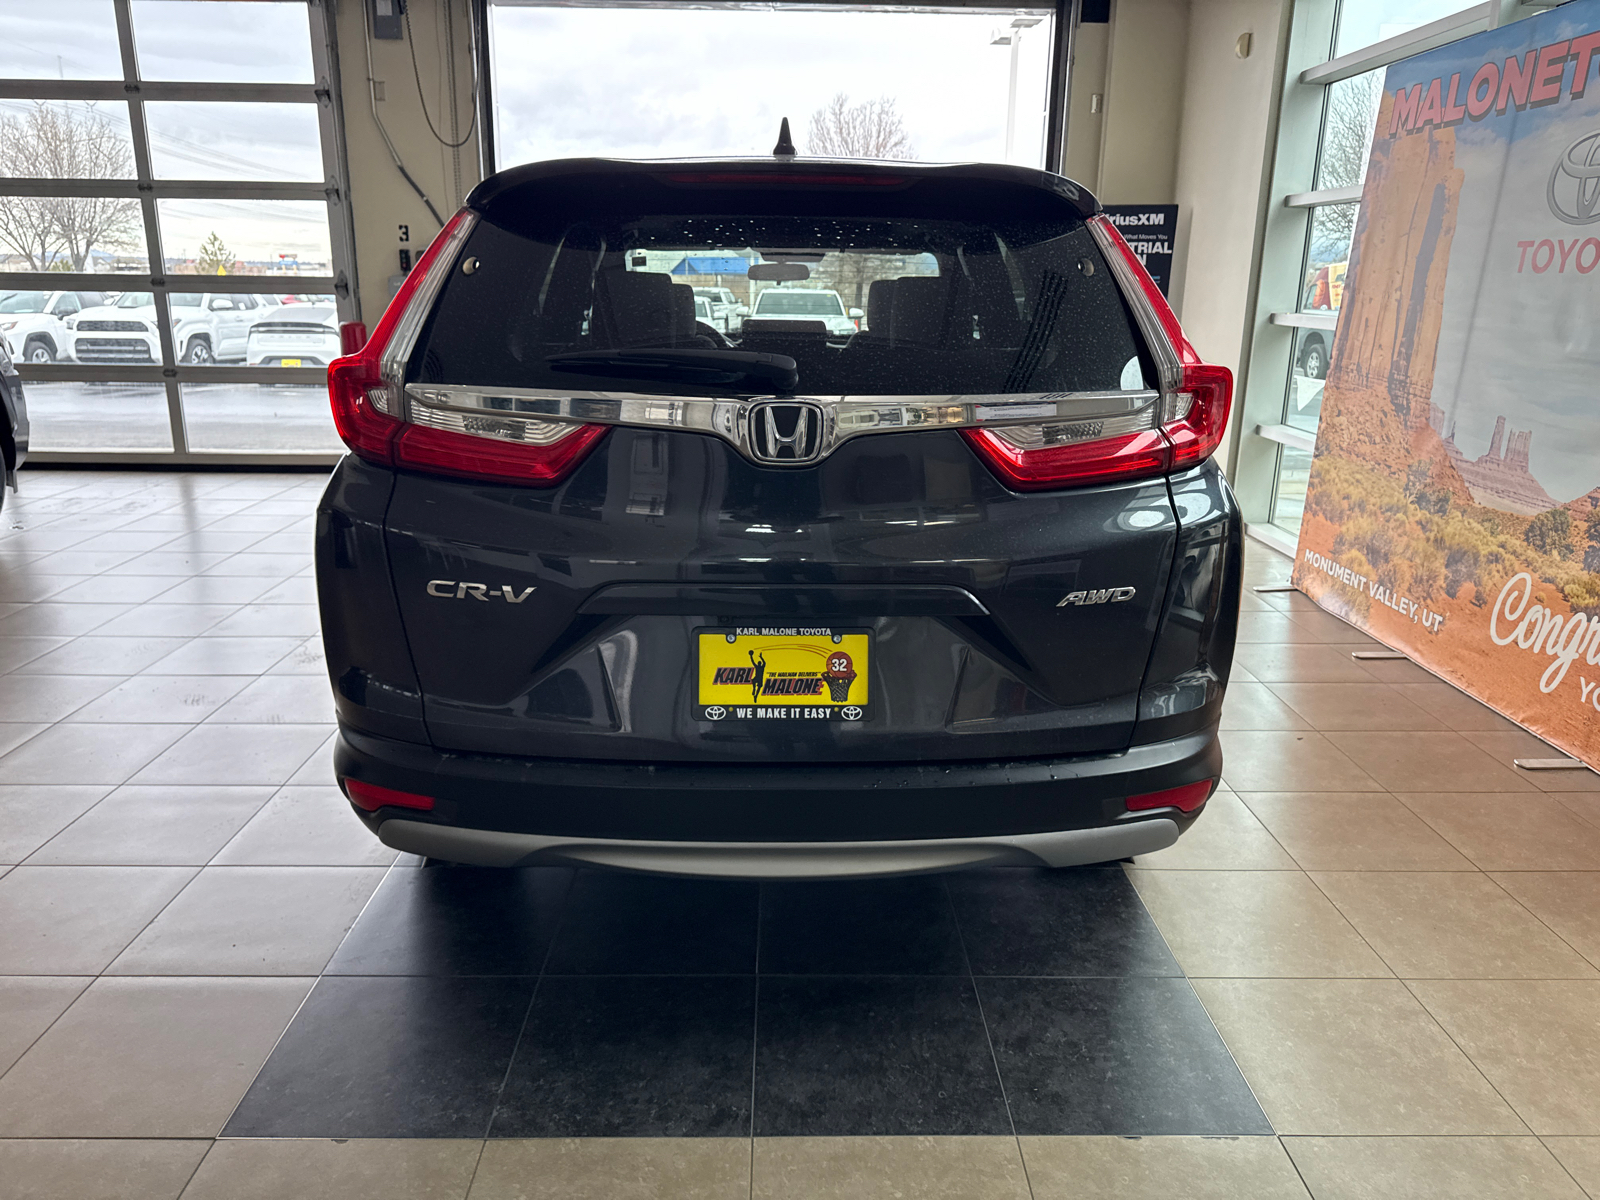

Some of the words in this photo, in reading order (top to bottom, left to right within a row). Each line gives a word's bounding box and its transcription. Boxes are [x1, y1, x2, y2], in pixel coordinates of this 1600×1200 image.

[1389, 31, 1600, 138] MALONET
[1106, 213, 1165, 226] riusXM
[399, 224, 409, 242] 3
[426, 579, 538, 604] CR-V
[1056, 586, 1136, 607] AWD
[1304, 548, 1367, 592] MONUMENT
[1369, 583, 1419, 624] VALLEY,
[1422, 611, 1443, 632] UT
[736, 627, 759, 636] KARL
[761, 627, 798, 636] MALONE
[799, 627, 832, 636] TOYOTA
[831, 658, 848, 672] 32
[712, 667, 755, 685] KARL
[761, 677, 824, 696] MALONE
[736, 707, 753, 719] WE
[757, 707, 787, 719] MAKE
[790, 707, 802, 719] IT
[804, 707, 832, 719] EASY
